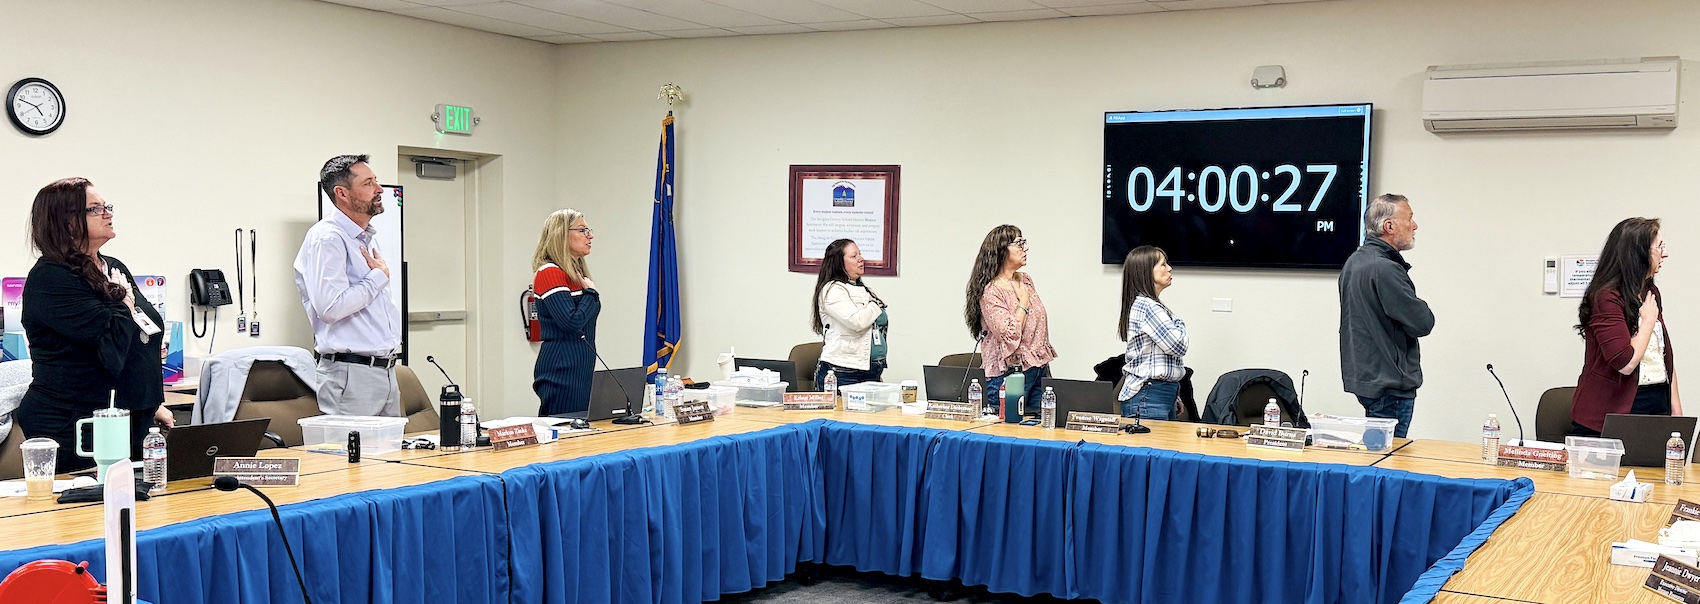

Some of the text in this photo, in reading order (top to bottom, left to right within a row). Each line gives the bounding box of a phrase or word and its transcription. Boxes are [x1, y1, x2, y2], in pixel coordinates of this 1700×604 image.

[446, 105, 471, 132] EXIT
[1128, 164, 1337, 212] 04:00:27
[1316, 220, 1334, 232] PM
[1504, 448, 1562, 460] Melinda Gneiting
[258, 462, 282, 470] Lopez
[1682, 569, 1700, 582] Dwyer
